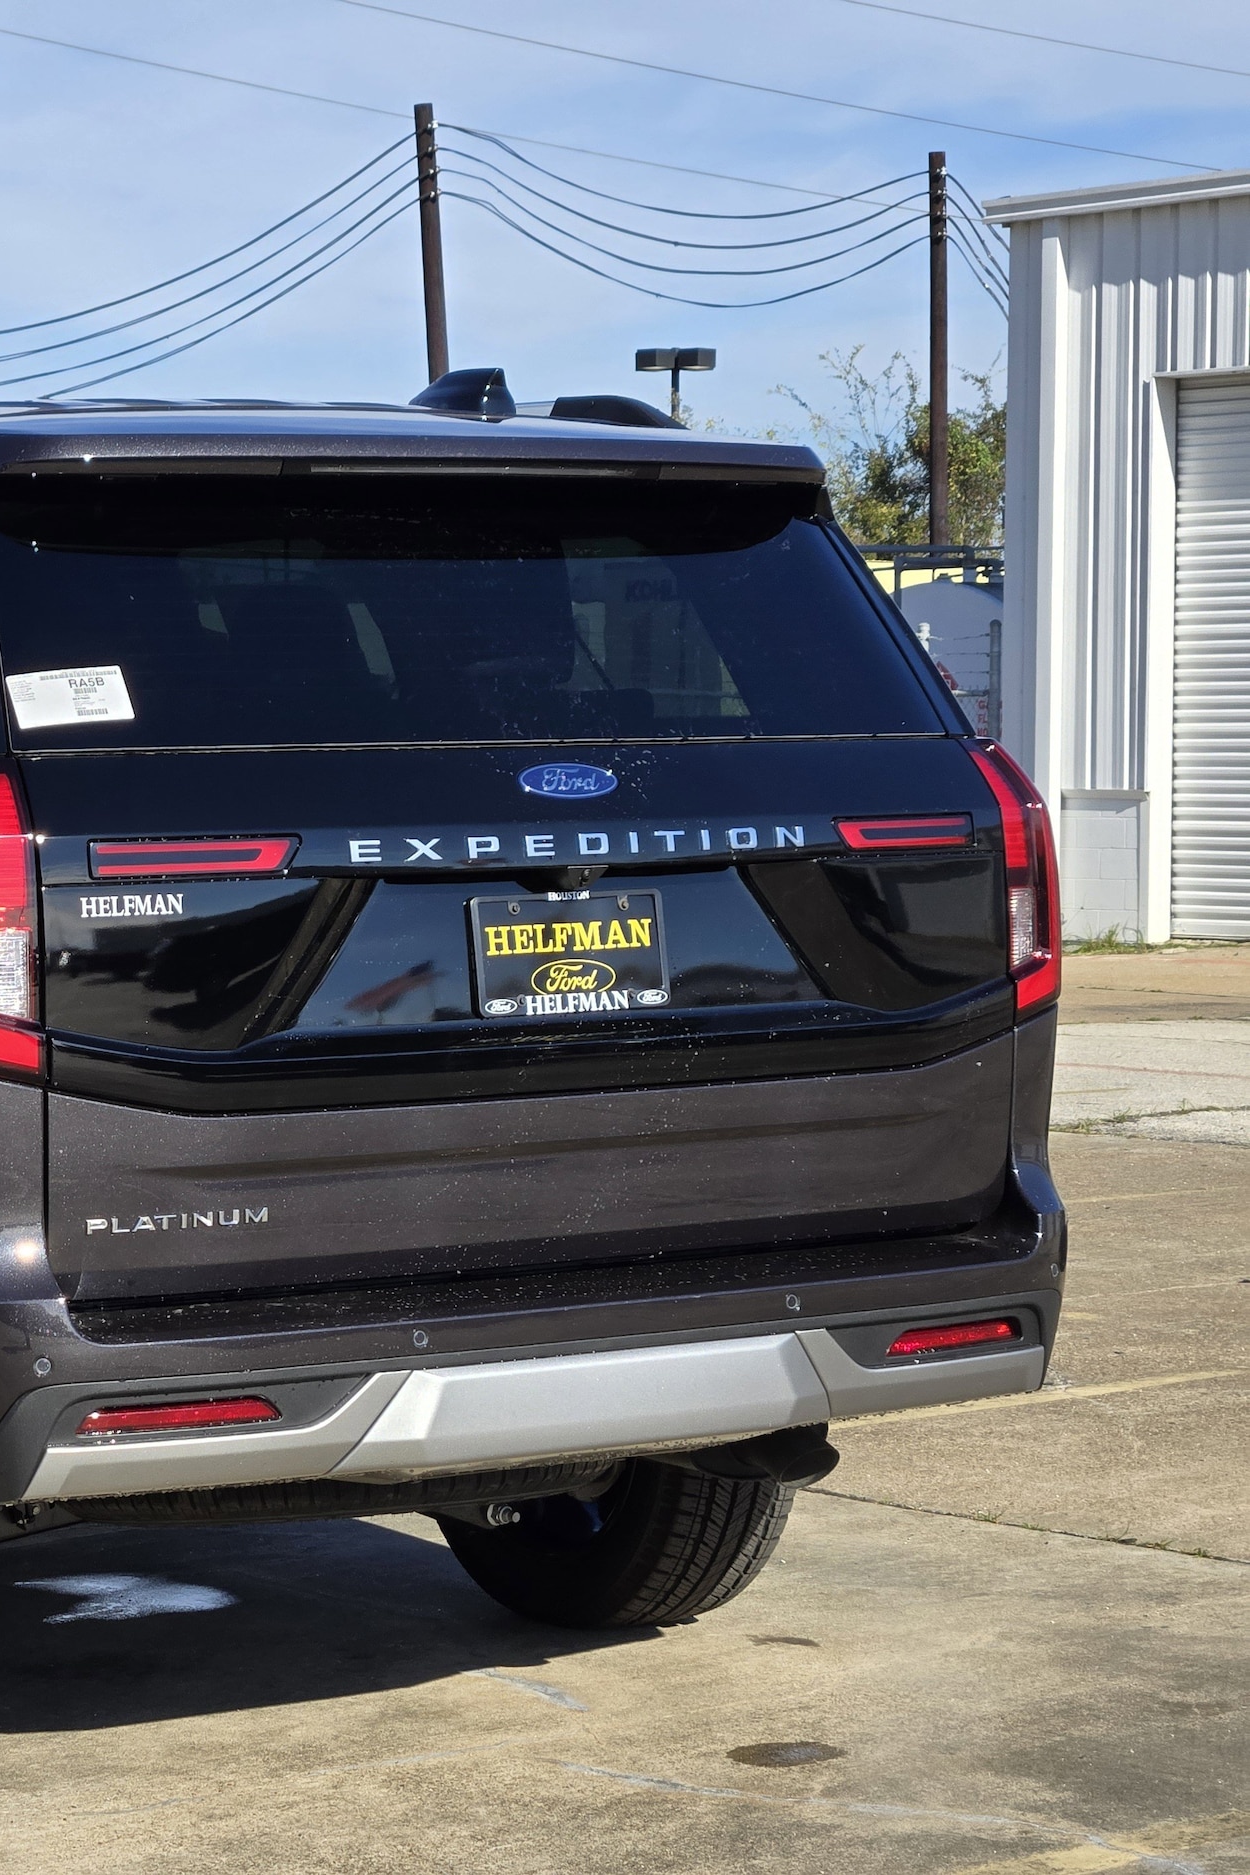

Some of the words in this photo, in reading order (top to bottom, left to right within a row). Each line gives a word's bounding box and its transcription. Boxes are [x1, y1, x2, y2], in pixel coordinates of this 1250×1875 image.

[349, 825, 806, 864] EXPEDITION
[80, 893, 184, 918] HELFMAN
[547, 890, 590, 901] HOUSTON
[485, 918, 652, 956] HELFMAN
[546, 964, 598, 992] Ford
[525, 990, 630, 1016] HELFMAN
[86, 1207, 269, 1235] PLATINUM
